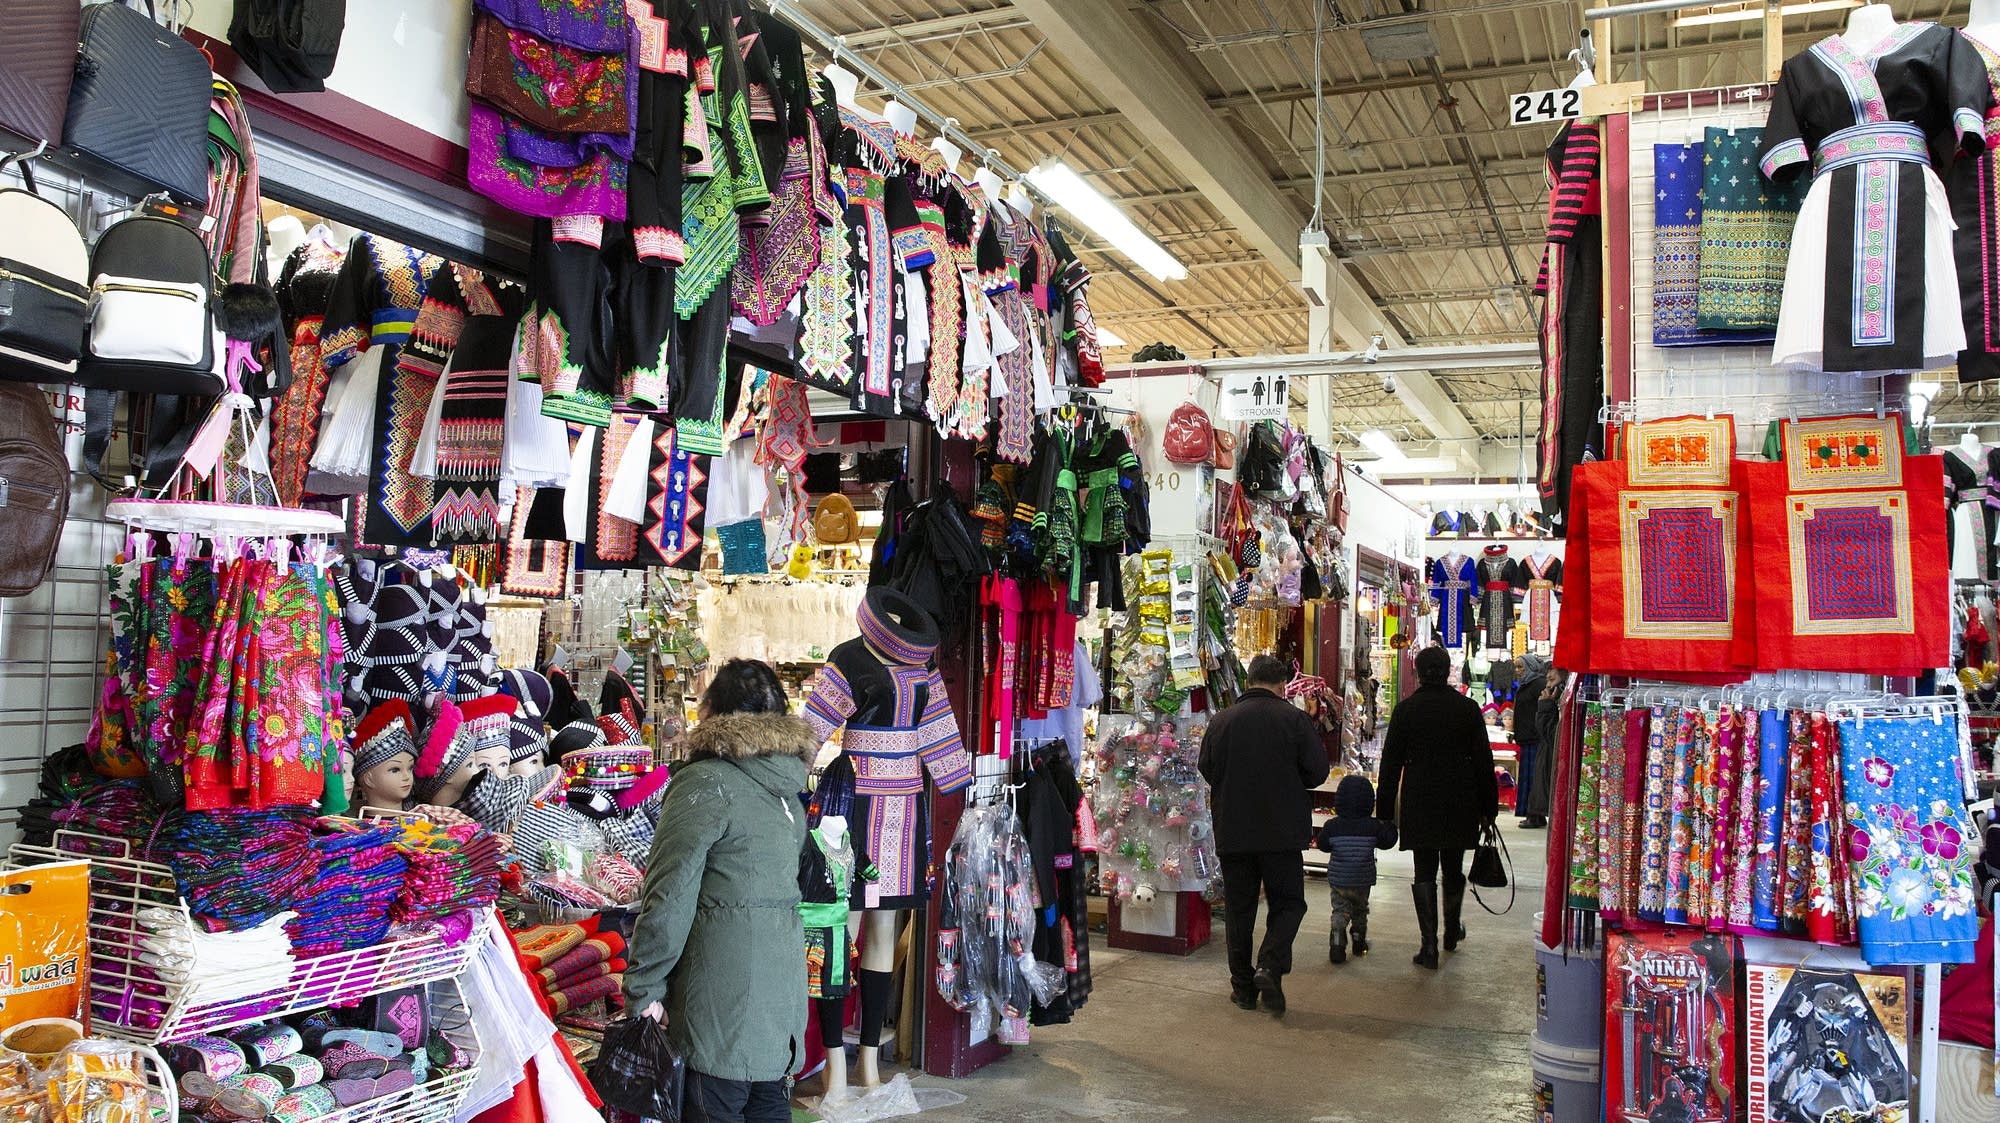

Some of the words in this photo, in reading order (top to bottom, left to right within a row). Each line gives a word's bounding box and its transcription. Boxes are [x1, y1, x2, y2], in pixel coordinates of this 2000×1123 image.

[1514, 89, 1579, 122] 242
[1234, 408, 1281, 417] STROOMS
[1643, 960, 1700, 977] NINJA
[1749, 971, 1765, 1077] DOMINATION
